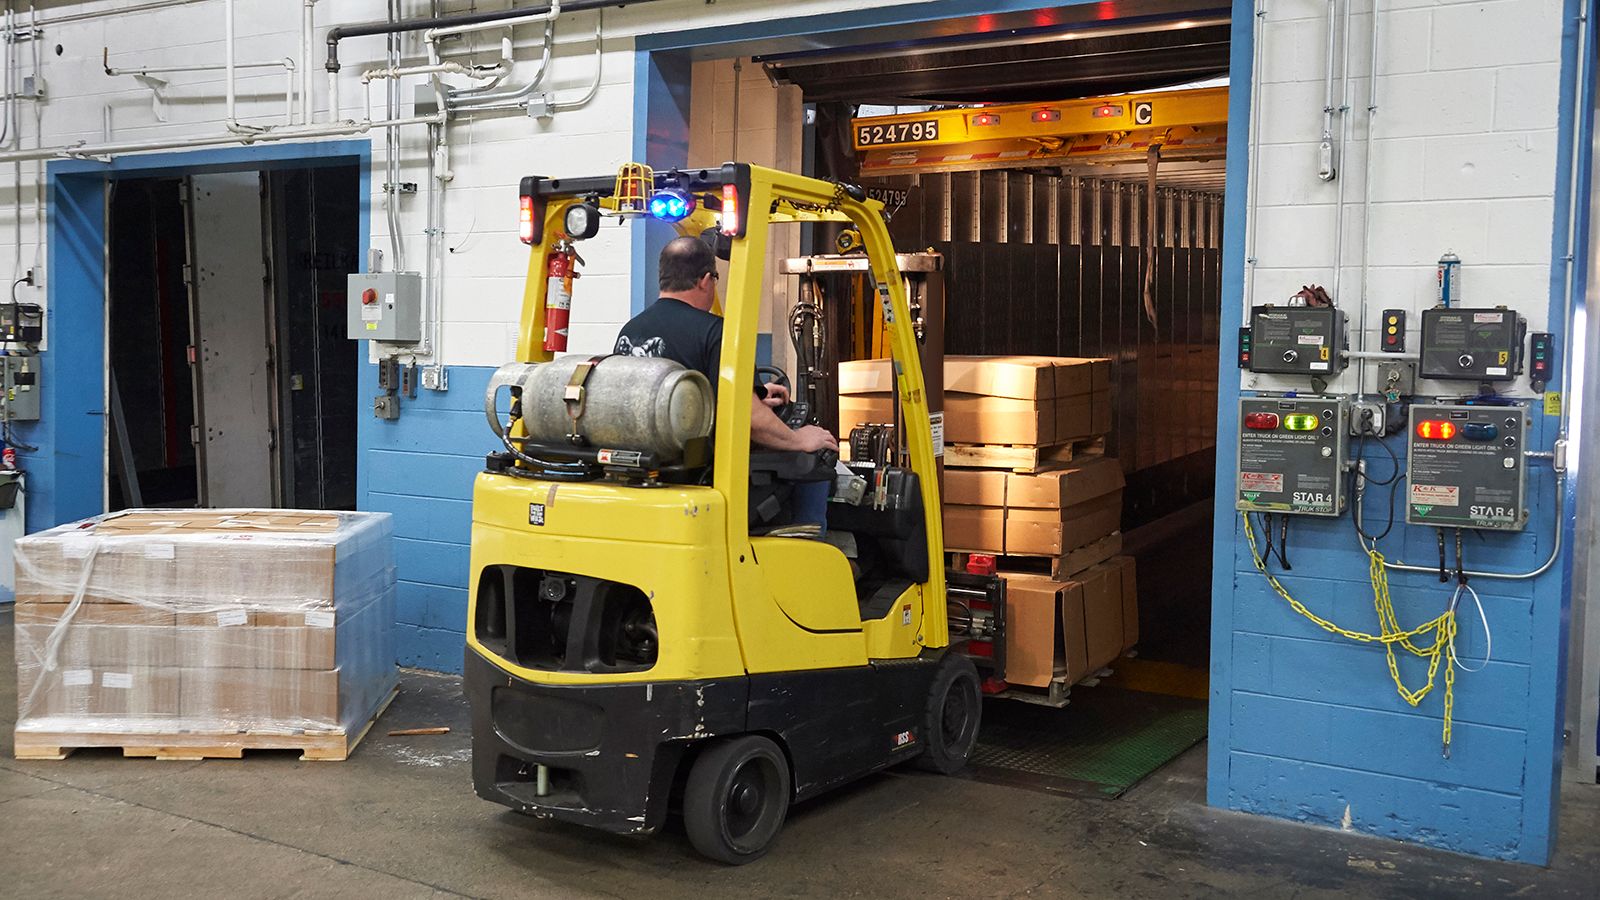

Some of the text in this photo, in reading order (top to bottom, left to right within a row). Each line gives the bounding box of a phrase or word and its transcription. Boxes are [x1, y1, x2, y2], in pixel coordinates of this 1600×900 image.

[1136, 103, 1152, 125] C
[859, 121, 938, 146] 524795
[869, 188, 907, 206] 524795
[1293, 491, 1333, 503] STAR 4
[1470, 505, 1515, 517] STAR 4
